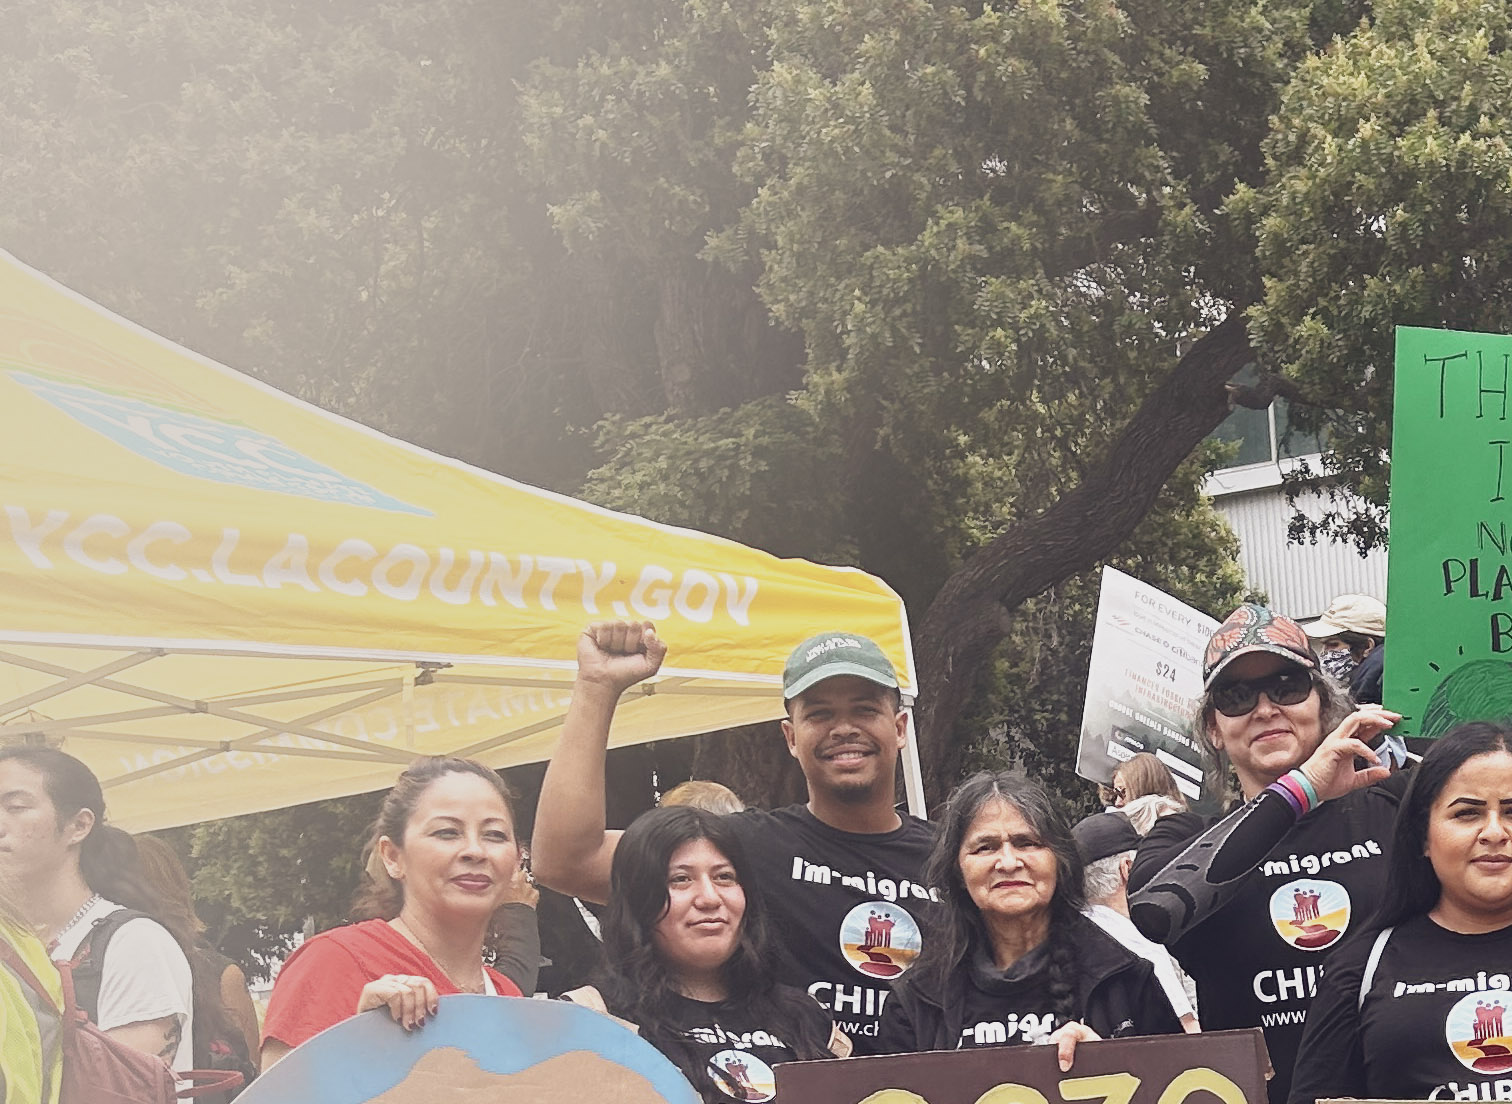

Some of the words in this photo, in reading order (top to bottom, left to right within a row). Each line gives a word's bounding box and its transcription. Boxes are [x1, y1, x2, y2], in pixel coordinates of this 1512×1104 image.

[3, 505, 759, 627] YCC.LACOUNTY.GOV
[1134, 591, 1156, 608] FOR
[1158, 603, 1192, 626] EVERY
[1155, 661, 1177, 682] $24
[1253, 965, 1325, 1003] CHI
